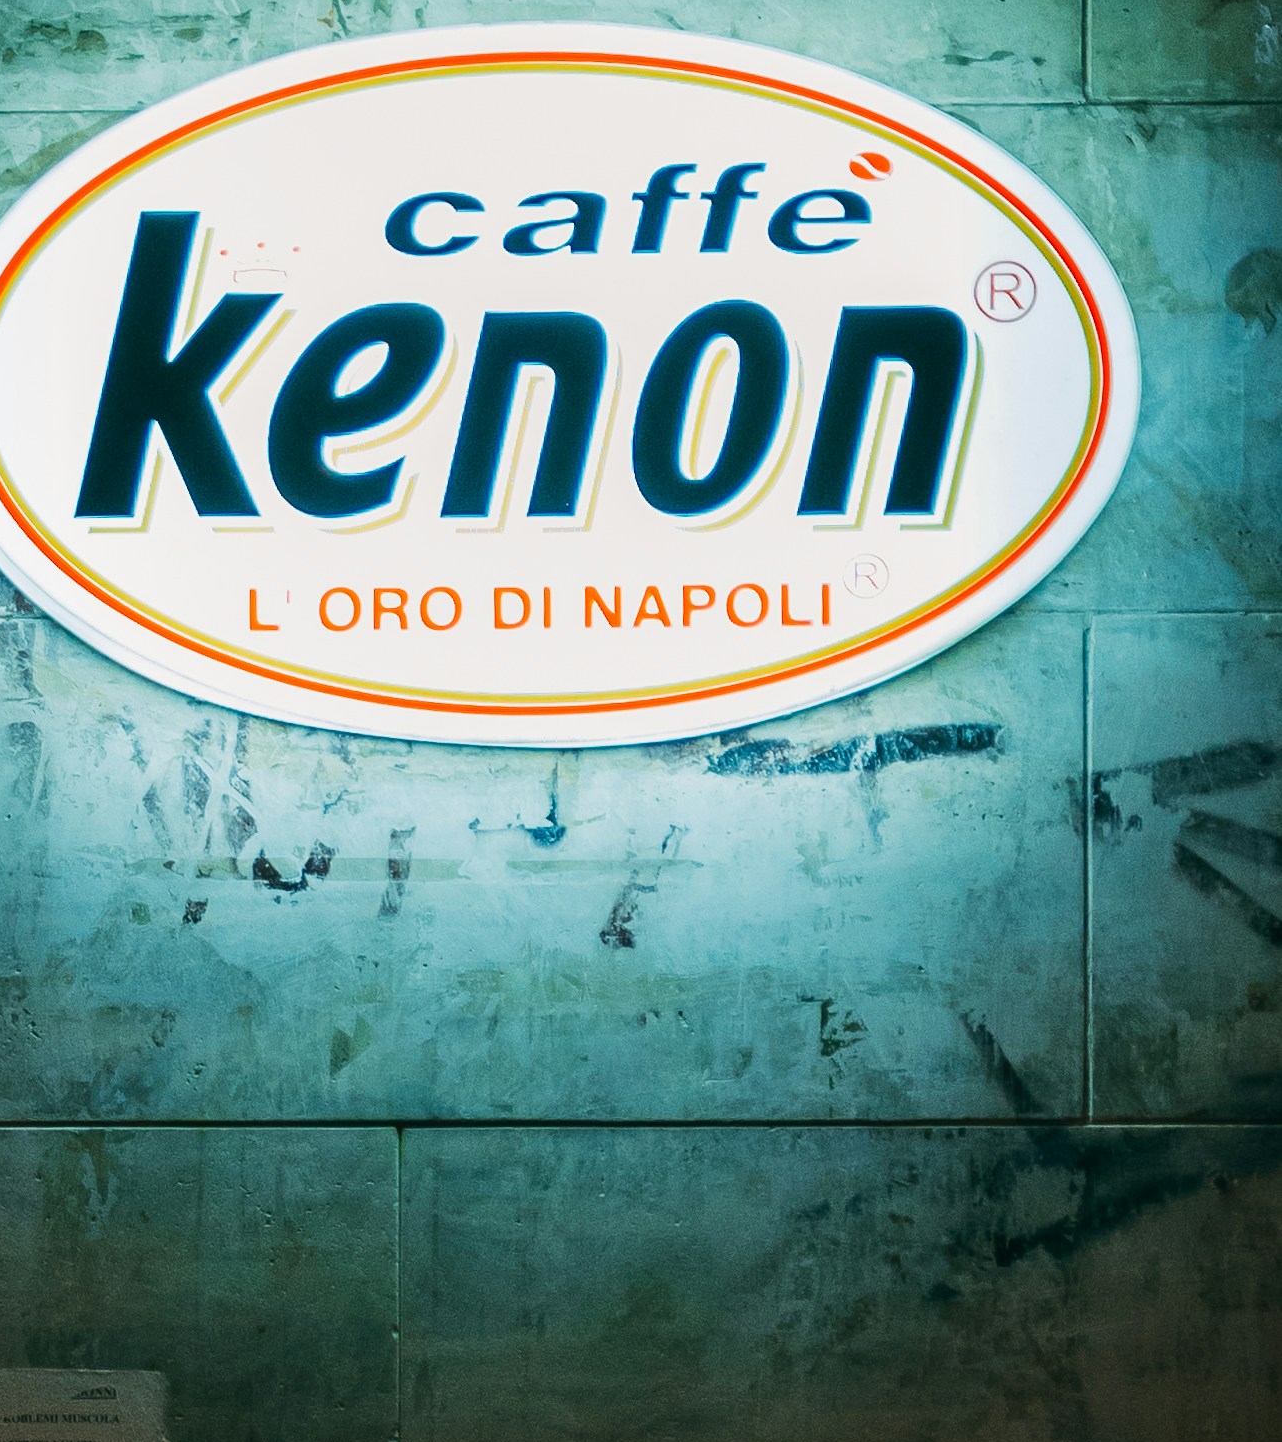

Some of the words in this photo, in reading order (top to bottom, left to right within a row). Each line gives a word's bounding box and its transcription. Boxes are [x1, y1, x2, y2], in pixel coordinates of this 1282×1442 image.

[74, 210, 971, 519] kenon
[317, 585, 463, 631] ORO
[492, 585, 553, 630] DI
[583, 582, 831, 629] NAPOLI
